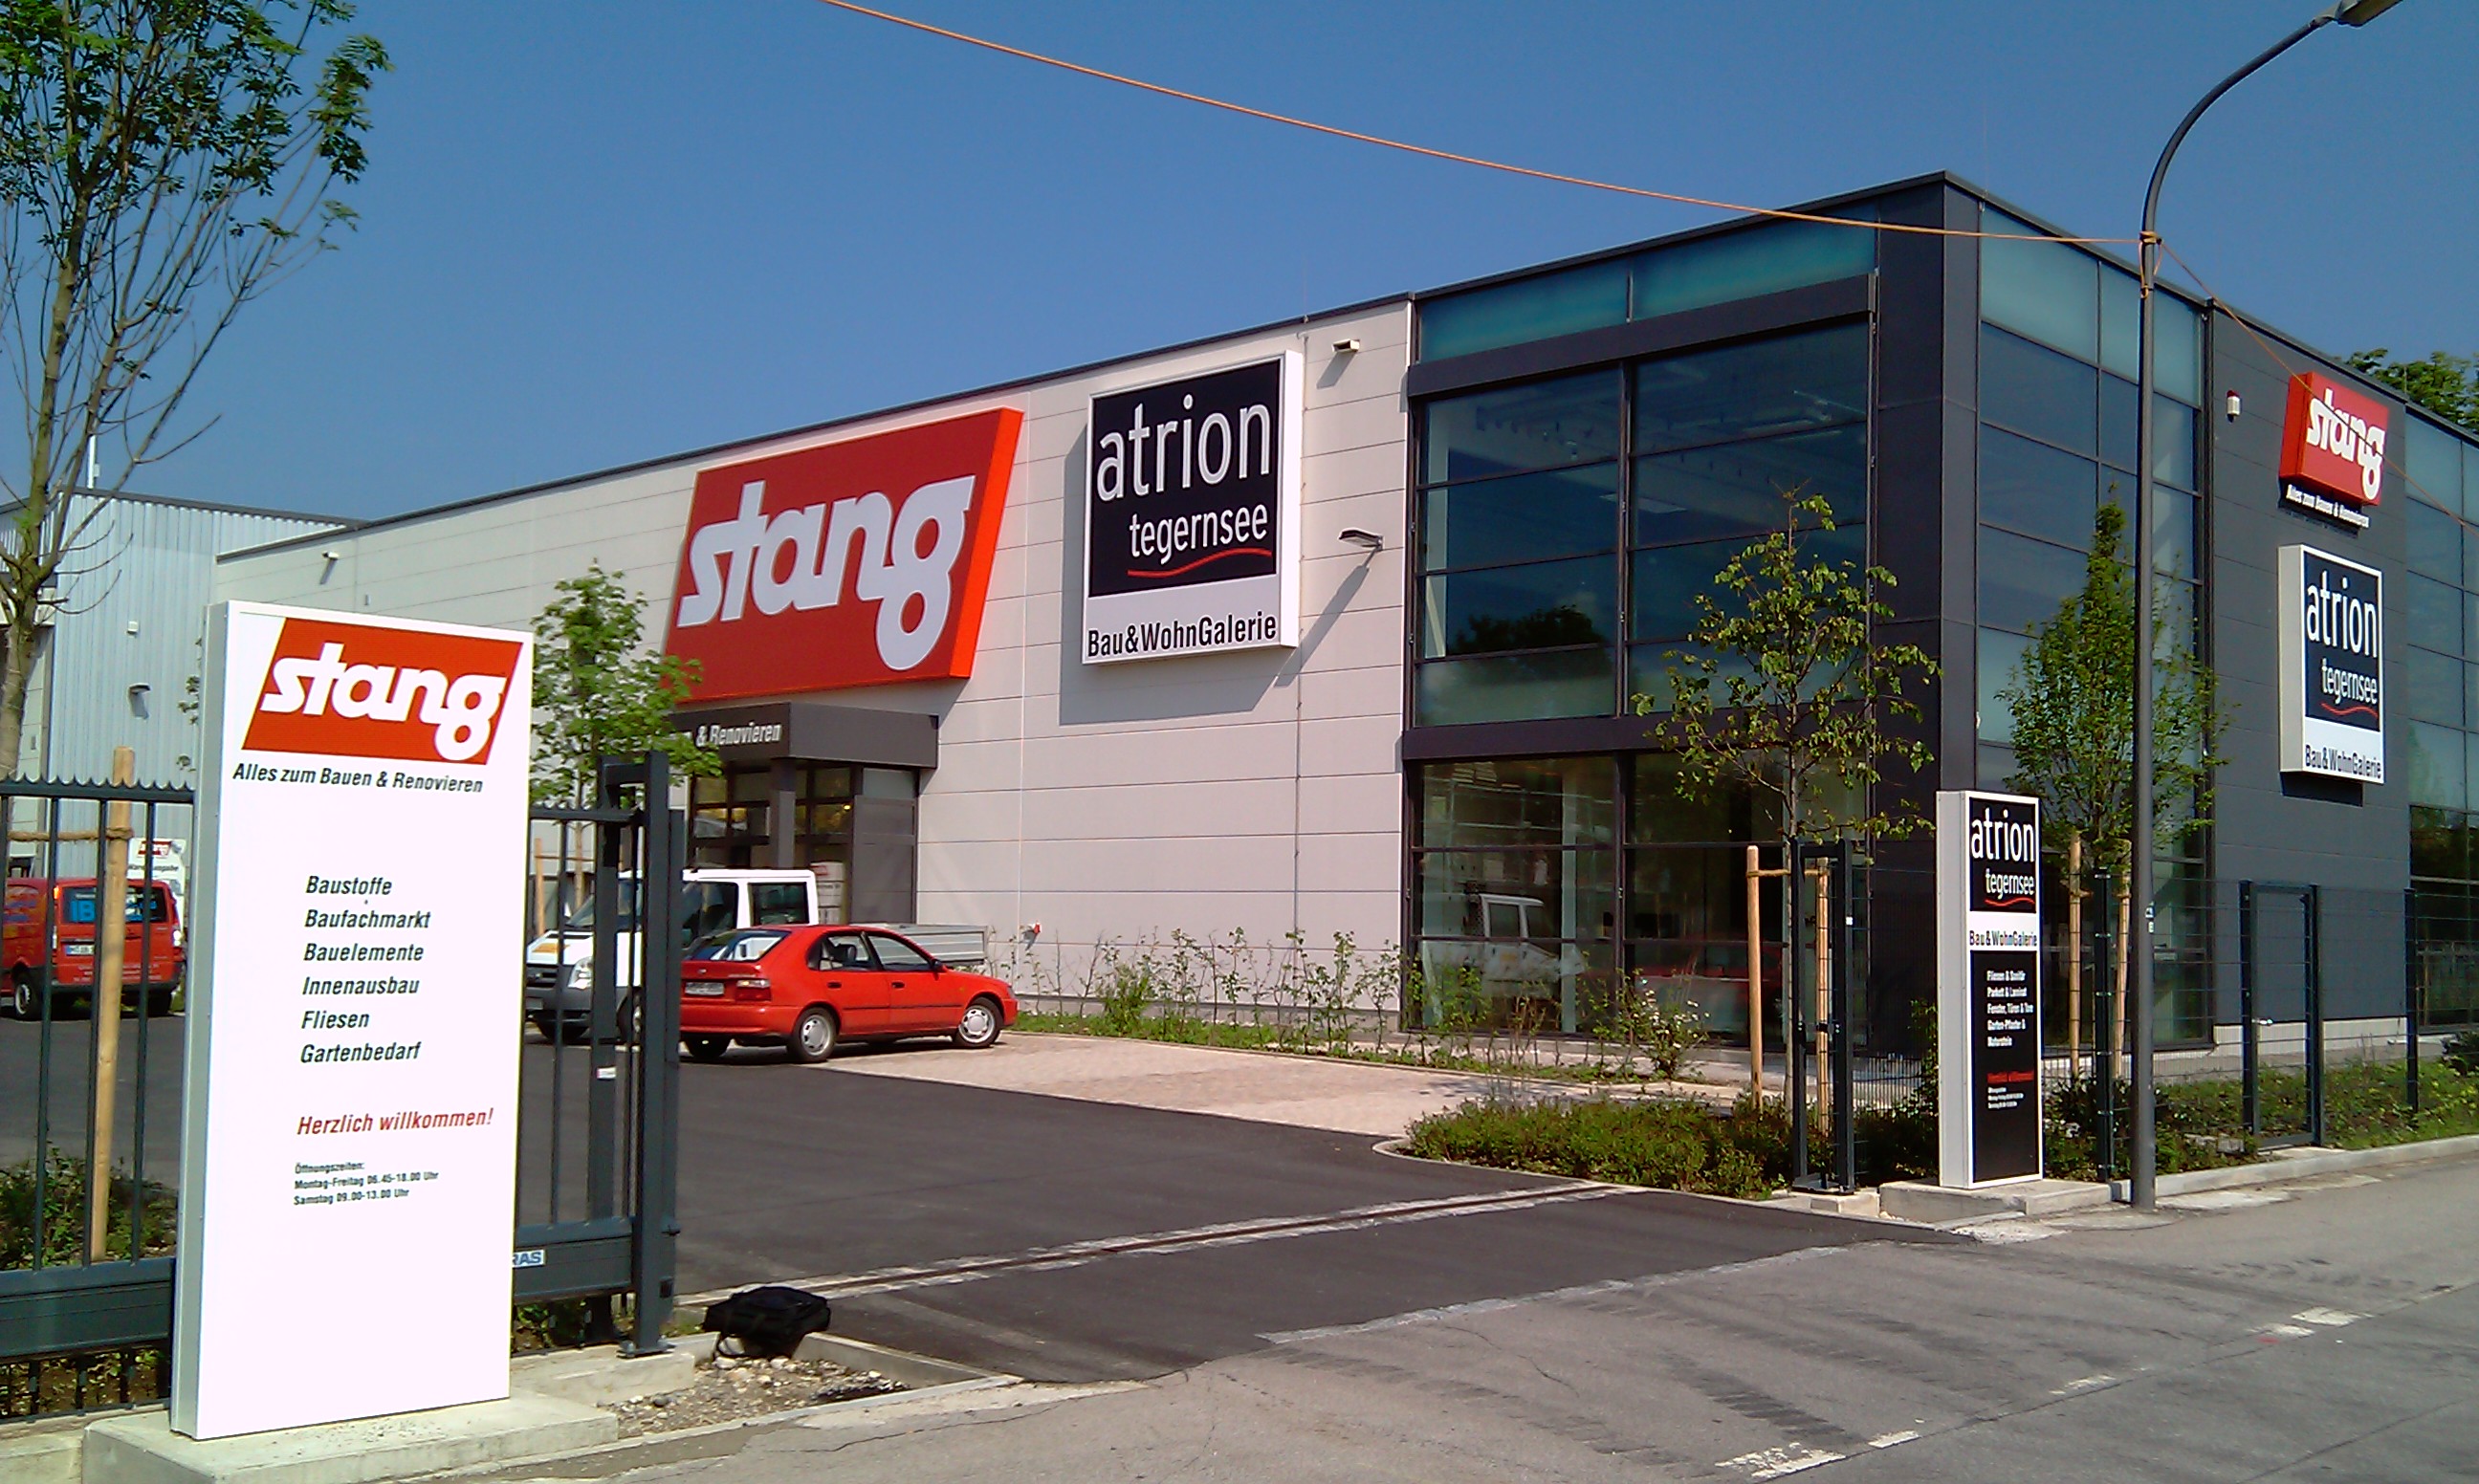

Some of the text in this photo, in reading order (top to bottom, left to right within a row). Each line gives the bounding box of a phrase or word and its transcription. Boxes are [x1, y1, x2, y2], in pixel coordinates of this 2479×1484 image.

[1097, 394, 1270, 501] atrion
[2306, 387, 2385, 501] stang
[1130, 504, 1268, 565] tegernsee
[676, 475, 976, 670] stang
[2306, 571, 2378, 658] atrion
[2321, 658, 2378, 705] tegernsee
[259, 641, 508, 761] stang
[695, 725, 708, 747] &
[710, 721, 782, 746] Renovieren
[232, 763, 484, 794] Alles zum Bauen & Renovieren
[1971, 807, 2035, 862] atrion
[305, 875, 393, 896] Baustoffe
[1985, 867, 2035, 900] tegernsee
[304, 909, 431, 928] Baufachmarkt
[303, 943, 424, 962] Bauelemente
[302, 976, 420, 995] Innenausbau
[301, 1010, 369, 1029] Fliesen
[300, 1041, 422, 1063] Gartenbedarf
[296, 1107, 494, 1135] Herzlich willkommen!
[294, 1194, 334, 1206] Samstag
